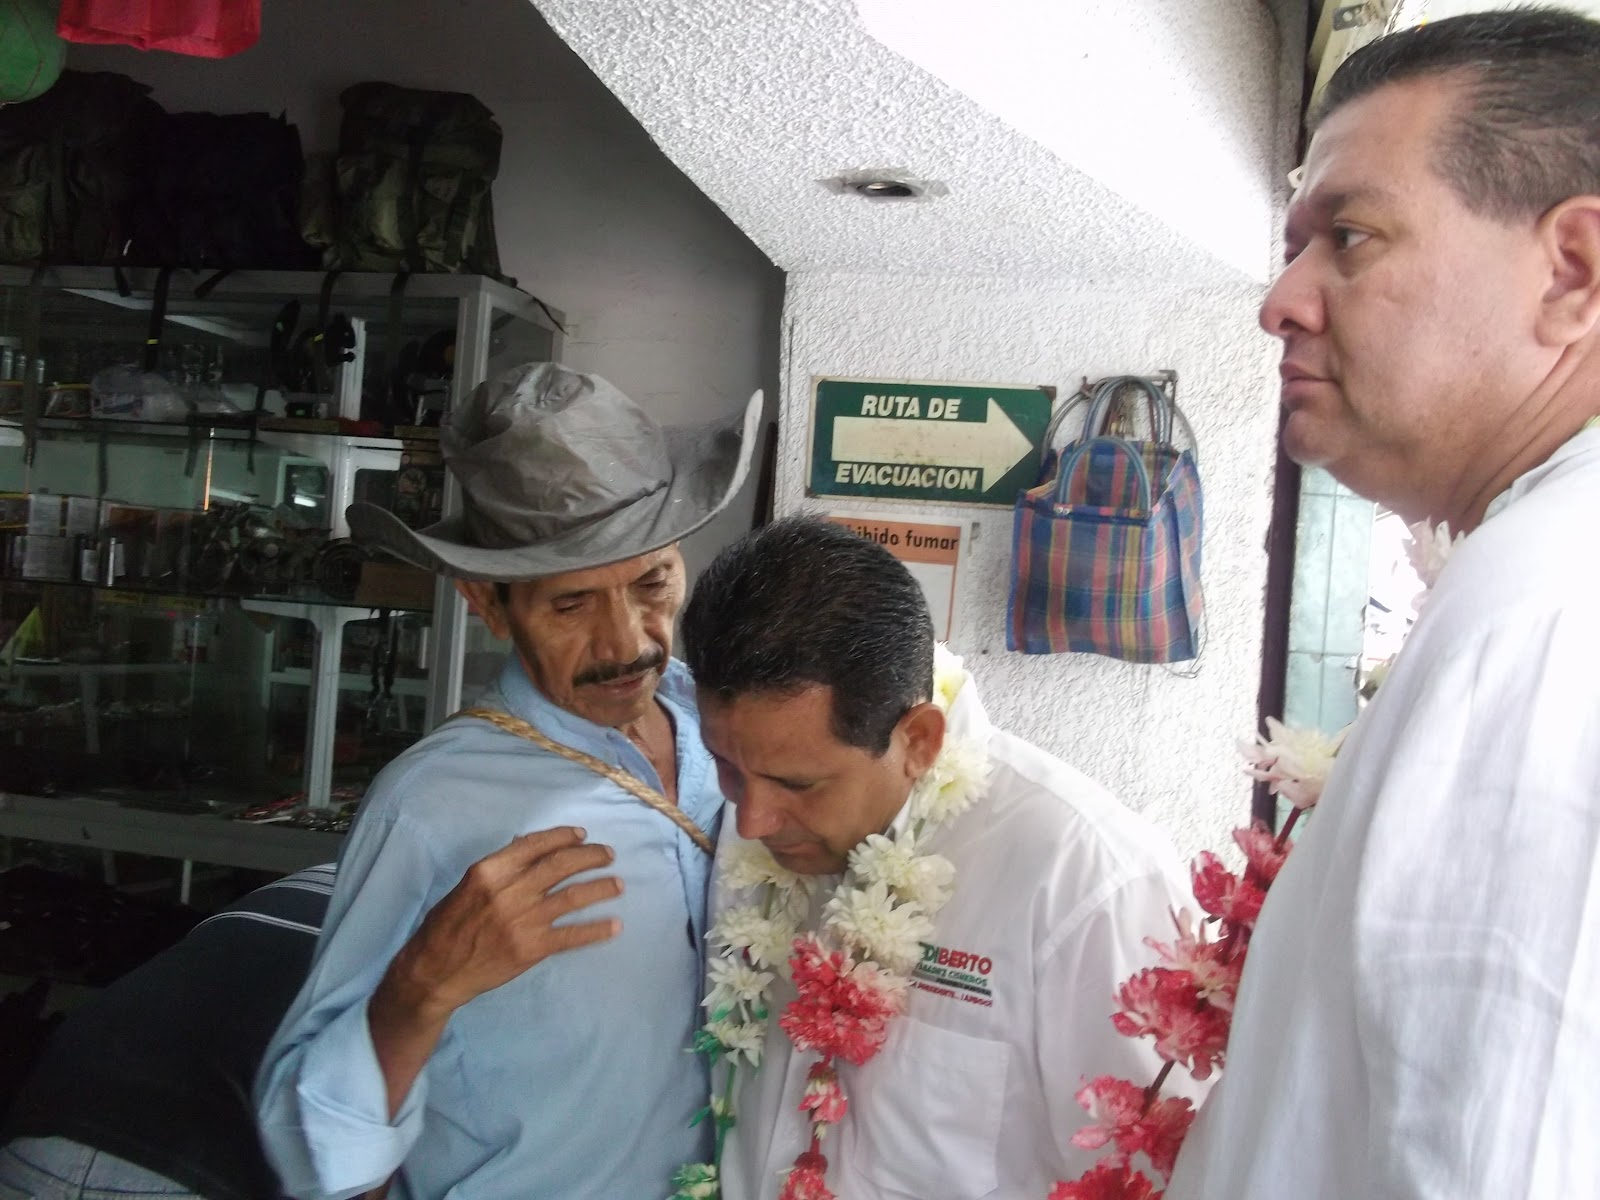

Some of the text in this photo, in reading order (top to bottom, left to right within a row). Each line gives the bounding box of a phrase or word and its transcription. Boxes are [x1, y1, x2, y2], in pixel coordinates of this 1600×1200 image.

[861, 395, 961, 419] RUTA DE
[835, 464, 978, 490] EVACUACION
[905, 530, 959, 550] fumar
